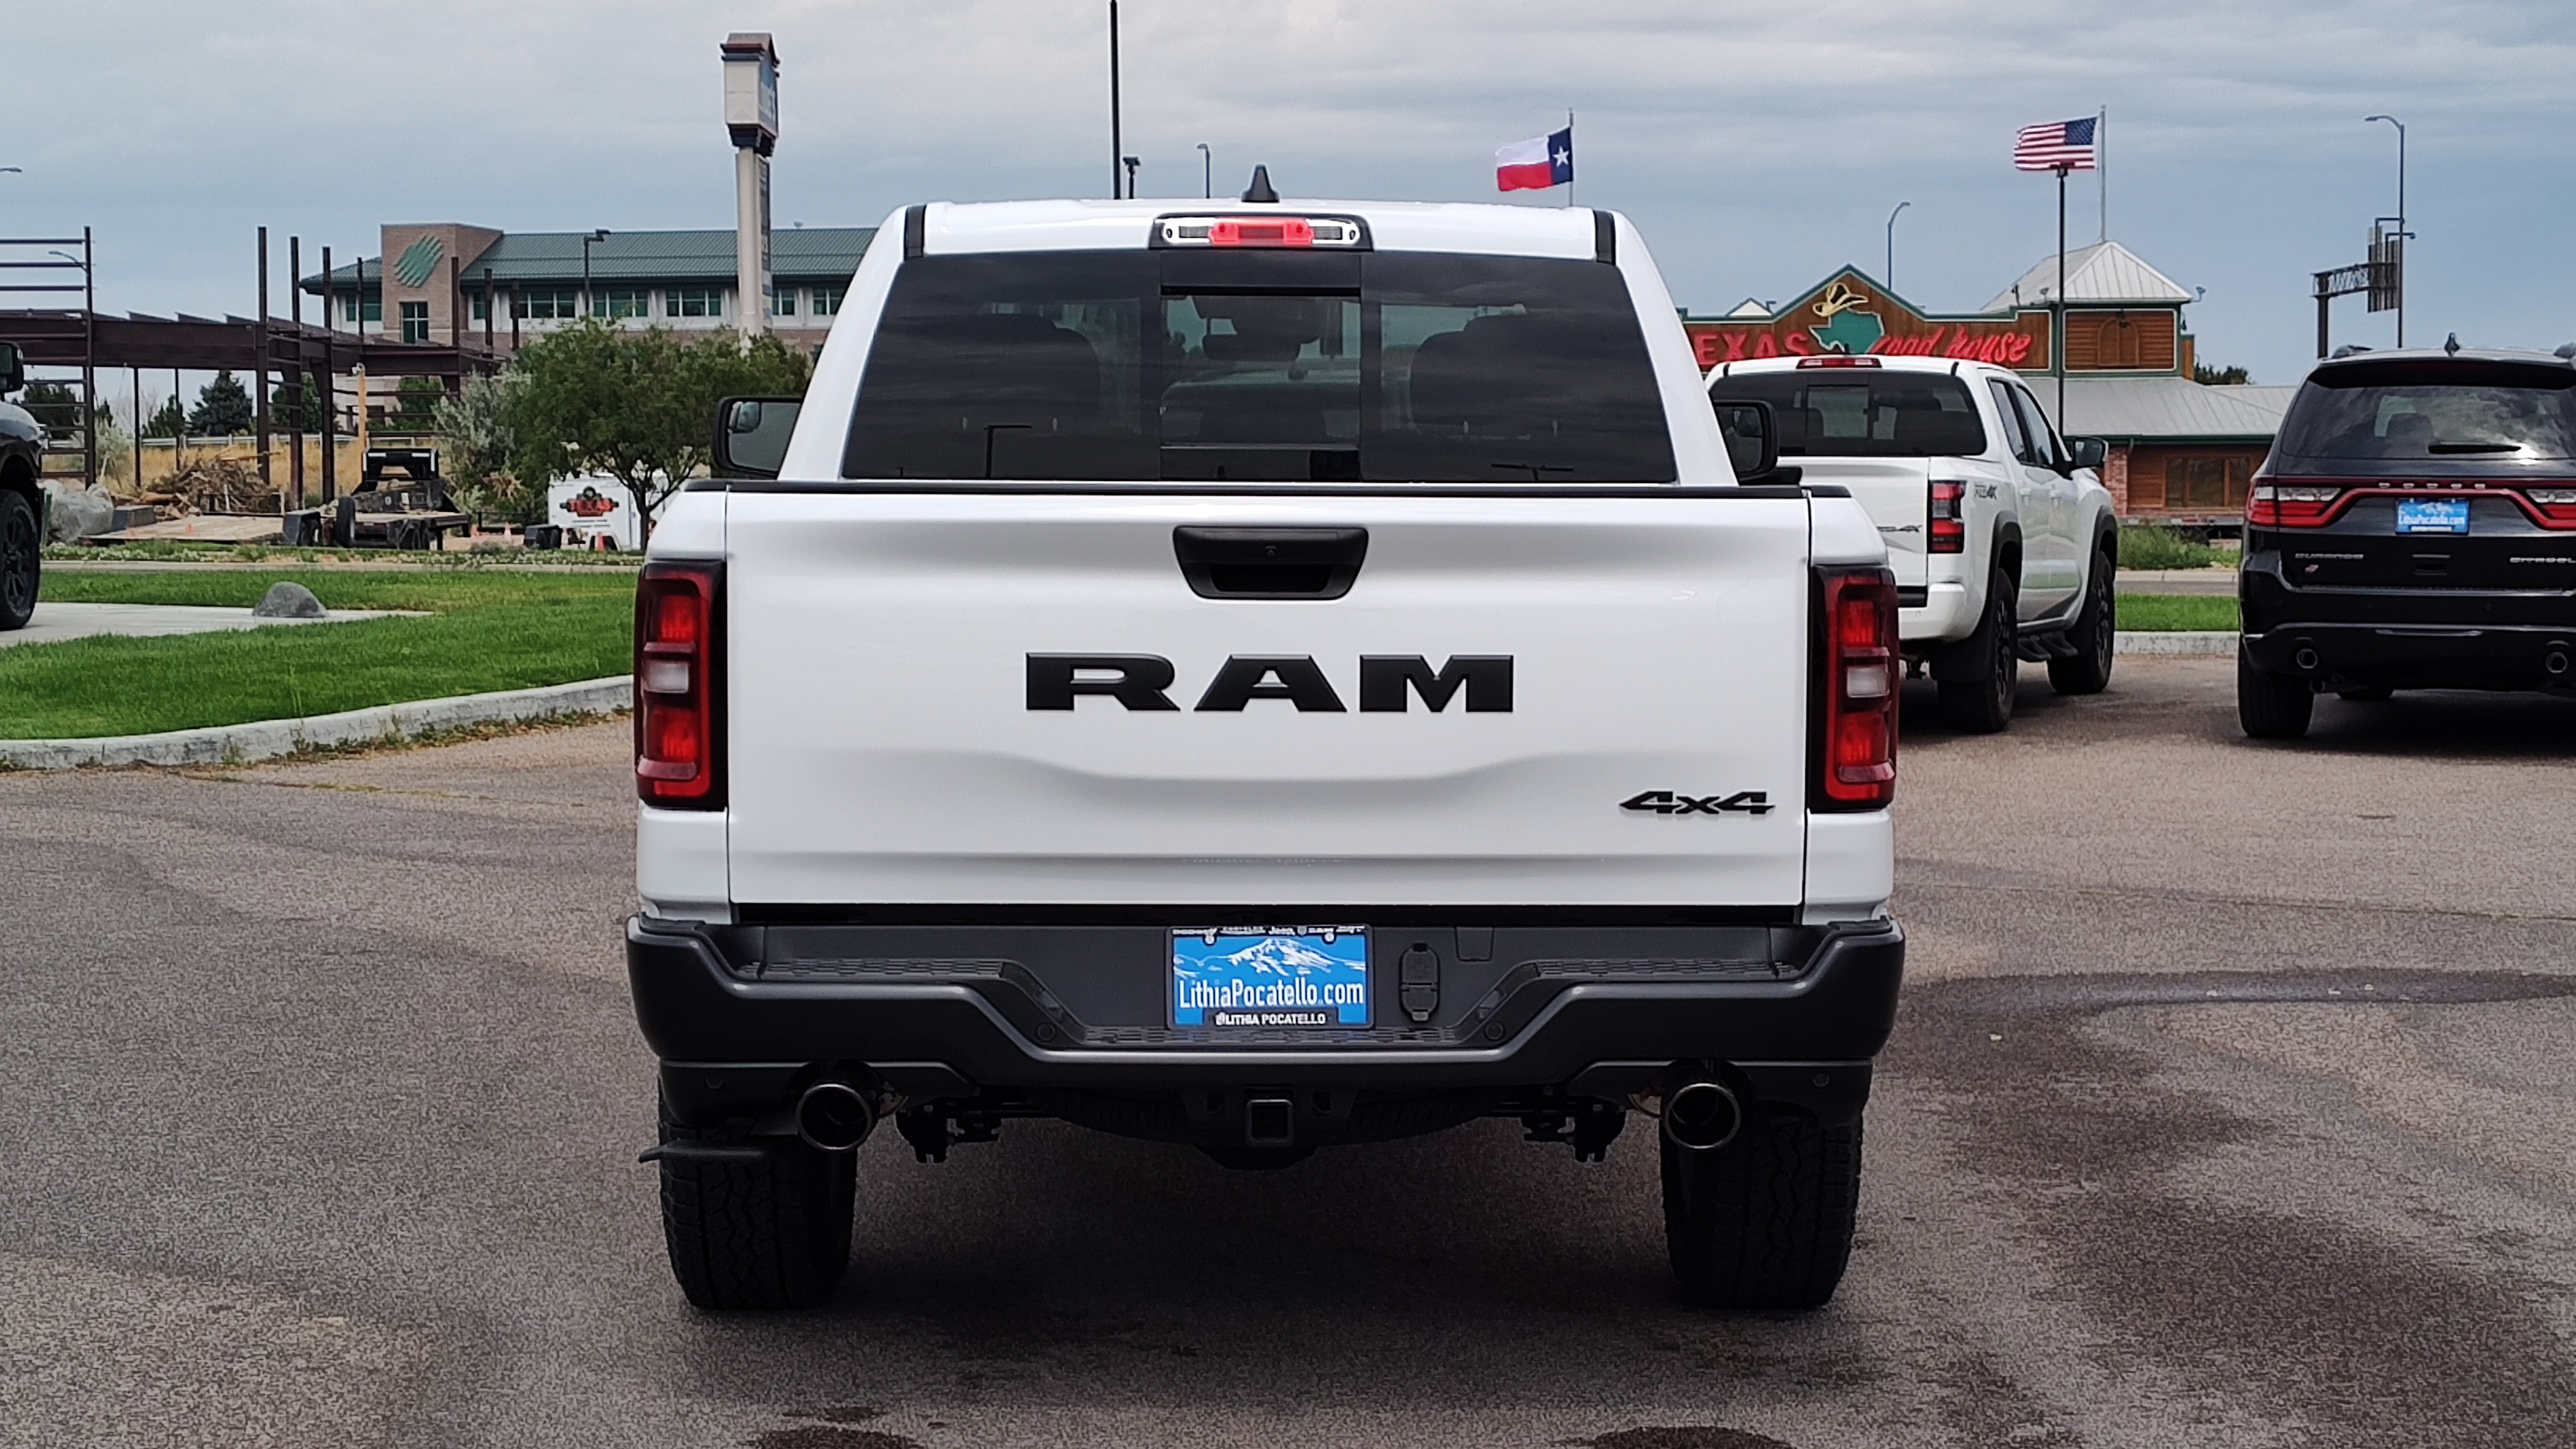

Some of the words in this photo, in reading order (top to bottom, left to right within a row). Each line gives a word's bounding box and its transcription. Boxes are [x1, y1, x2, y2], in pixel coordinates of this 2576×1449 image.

[1944, 325, 2034, 363] house
[1026, 652, 1514, 713] RAM
[1619, 791, 1776, 814] 4x4
[1179, 977, 1364, 1009] LithiaPocatello.com
[1226, 1013, 1260, 1025] LITHIA
[1261, 1013, 1326, 1025] POCATELLO
